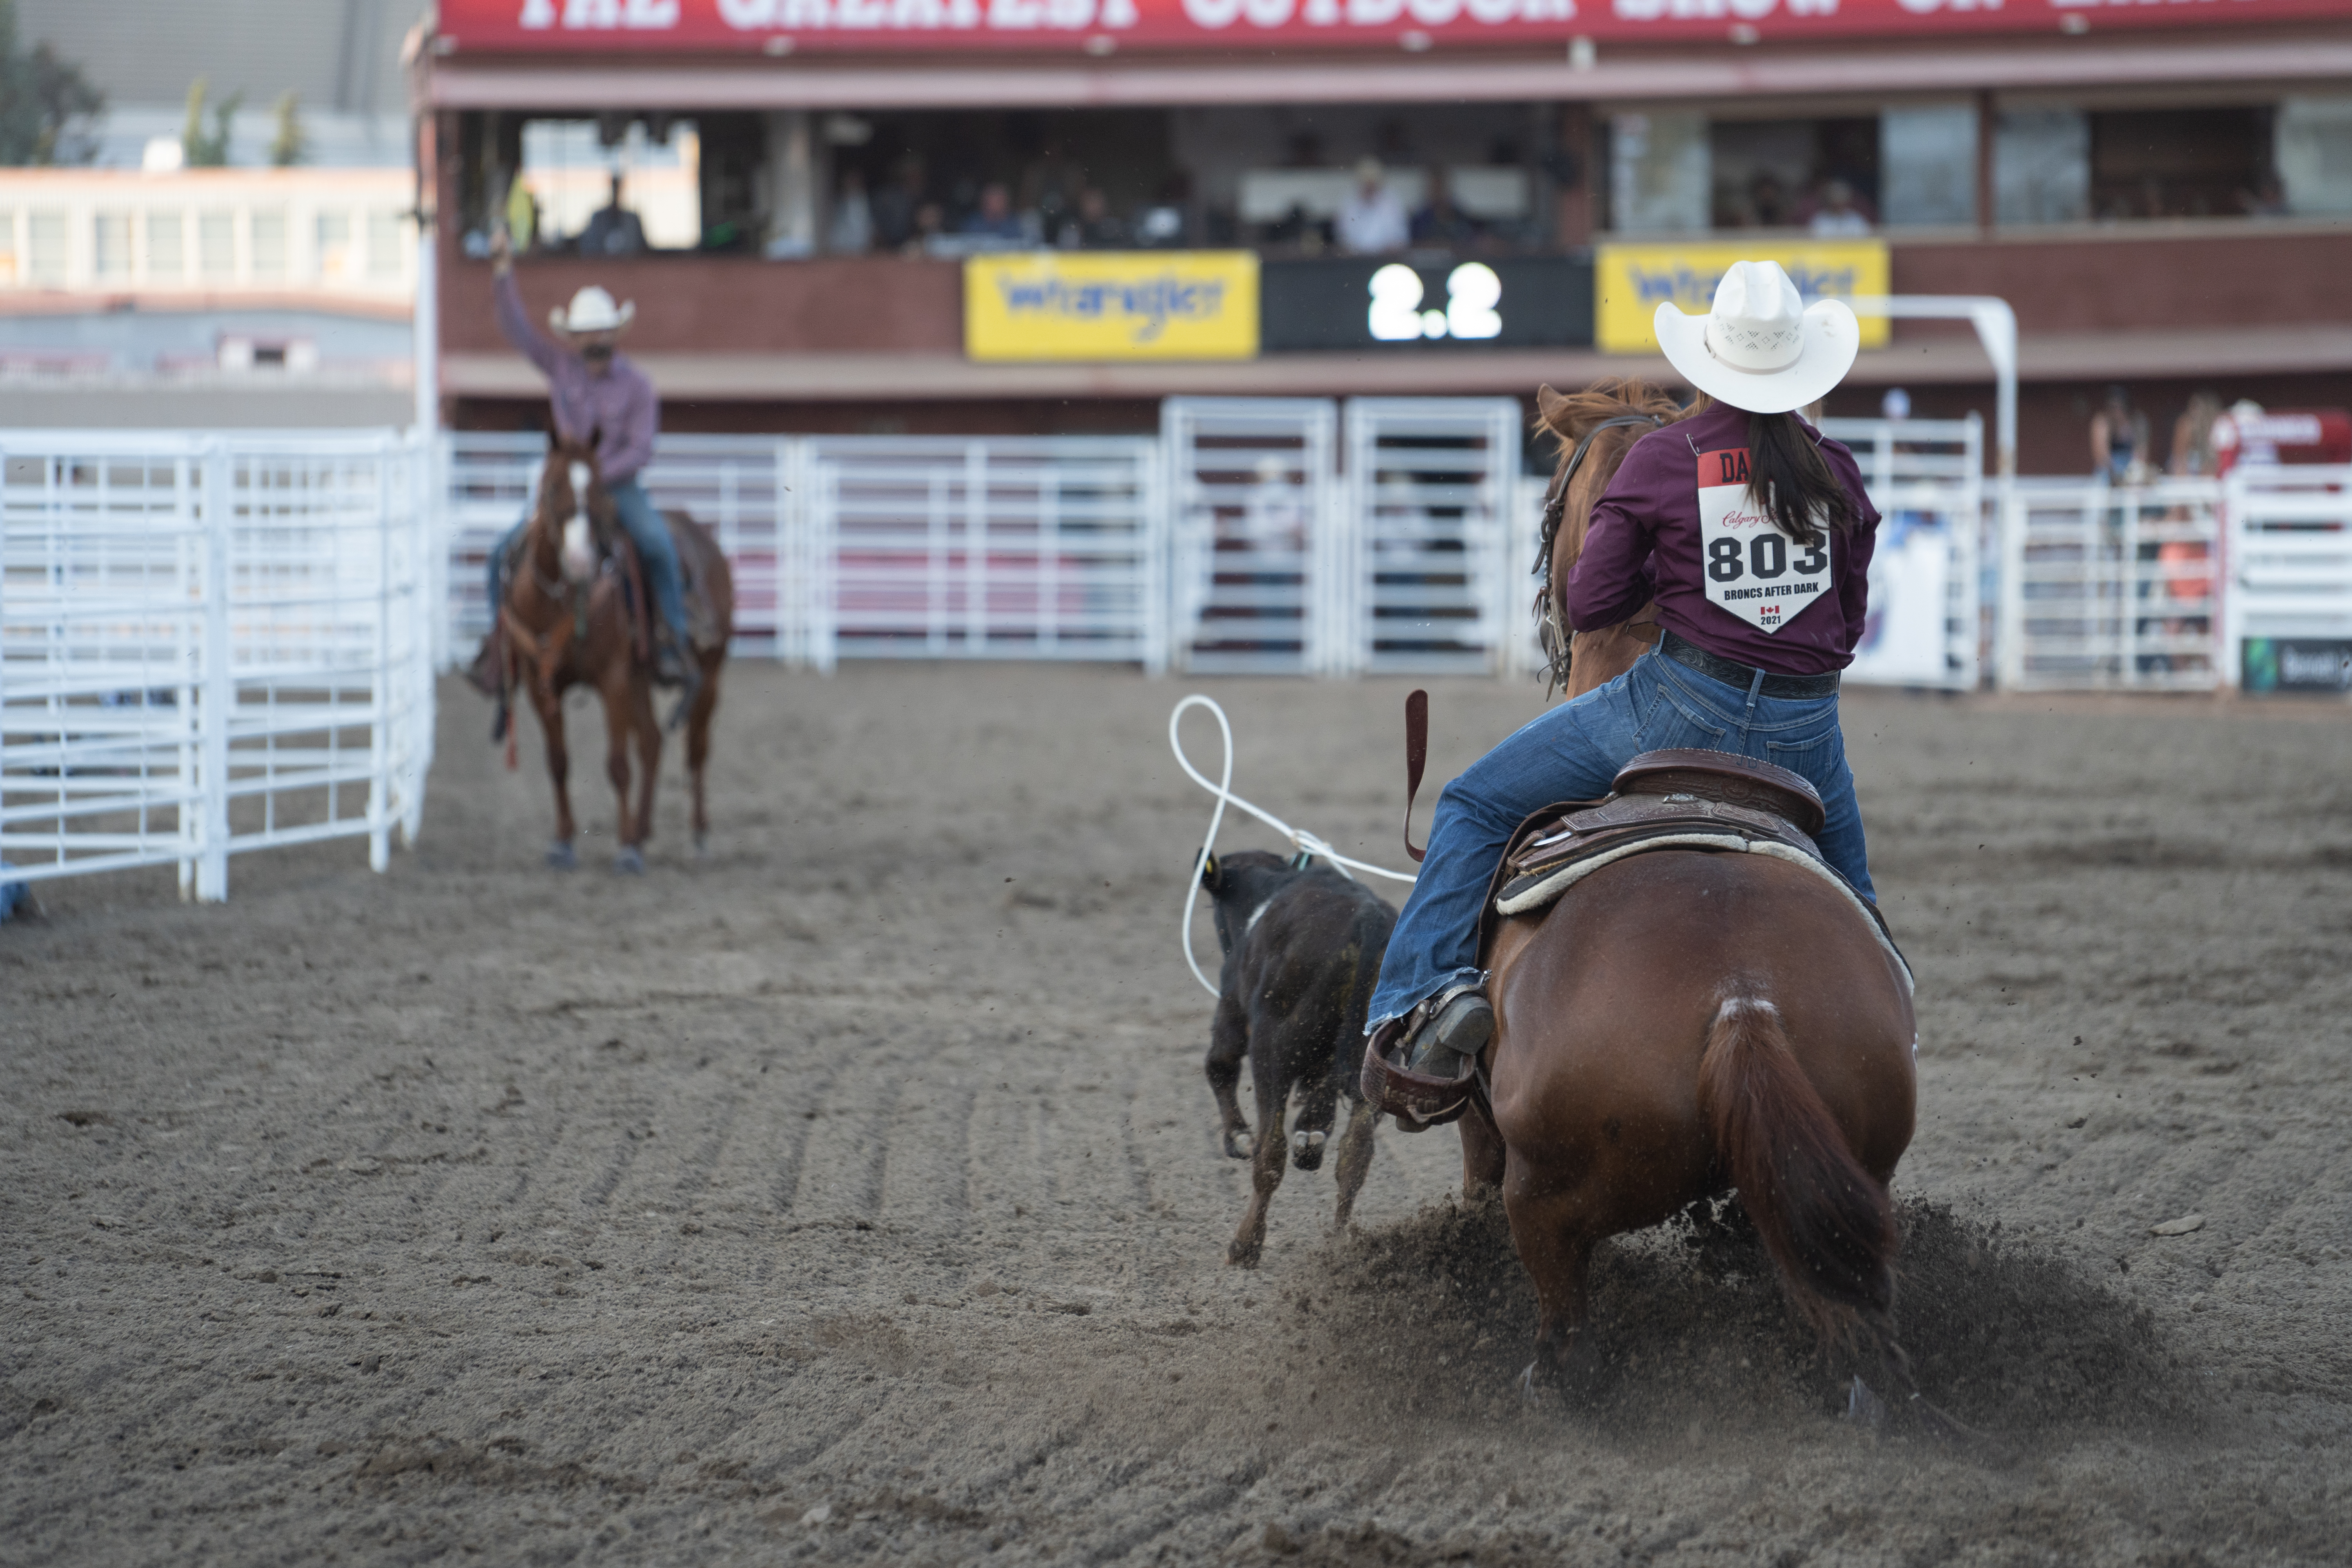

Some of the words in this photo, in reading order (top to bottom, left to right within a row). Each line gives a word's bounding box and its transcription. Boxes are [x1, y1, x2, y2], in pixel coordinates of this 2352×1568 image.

[1368, 262, 1502, 341] 2.2
[1722, 511, 1760, 529] Calgary
[1708, 530, 1828, 583] 803
[1724, 588, 1762, 600] BRONCS
[1765, 585, 1791, 597] AFTER
[1794, 582, 1819, 594] DARK
[1761, 615, 1780, 625] 2021
